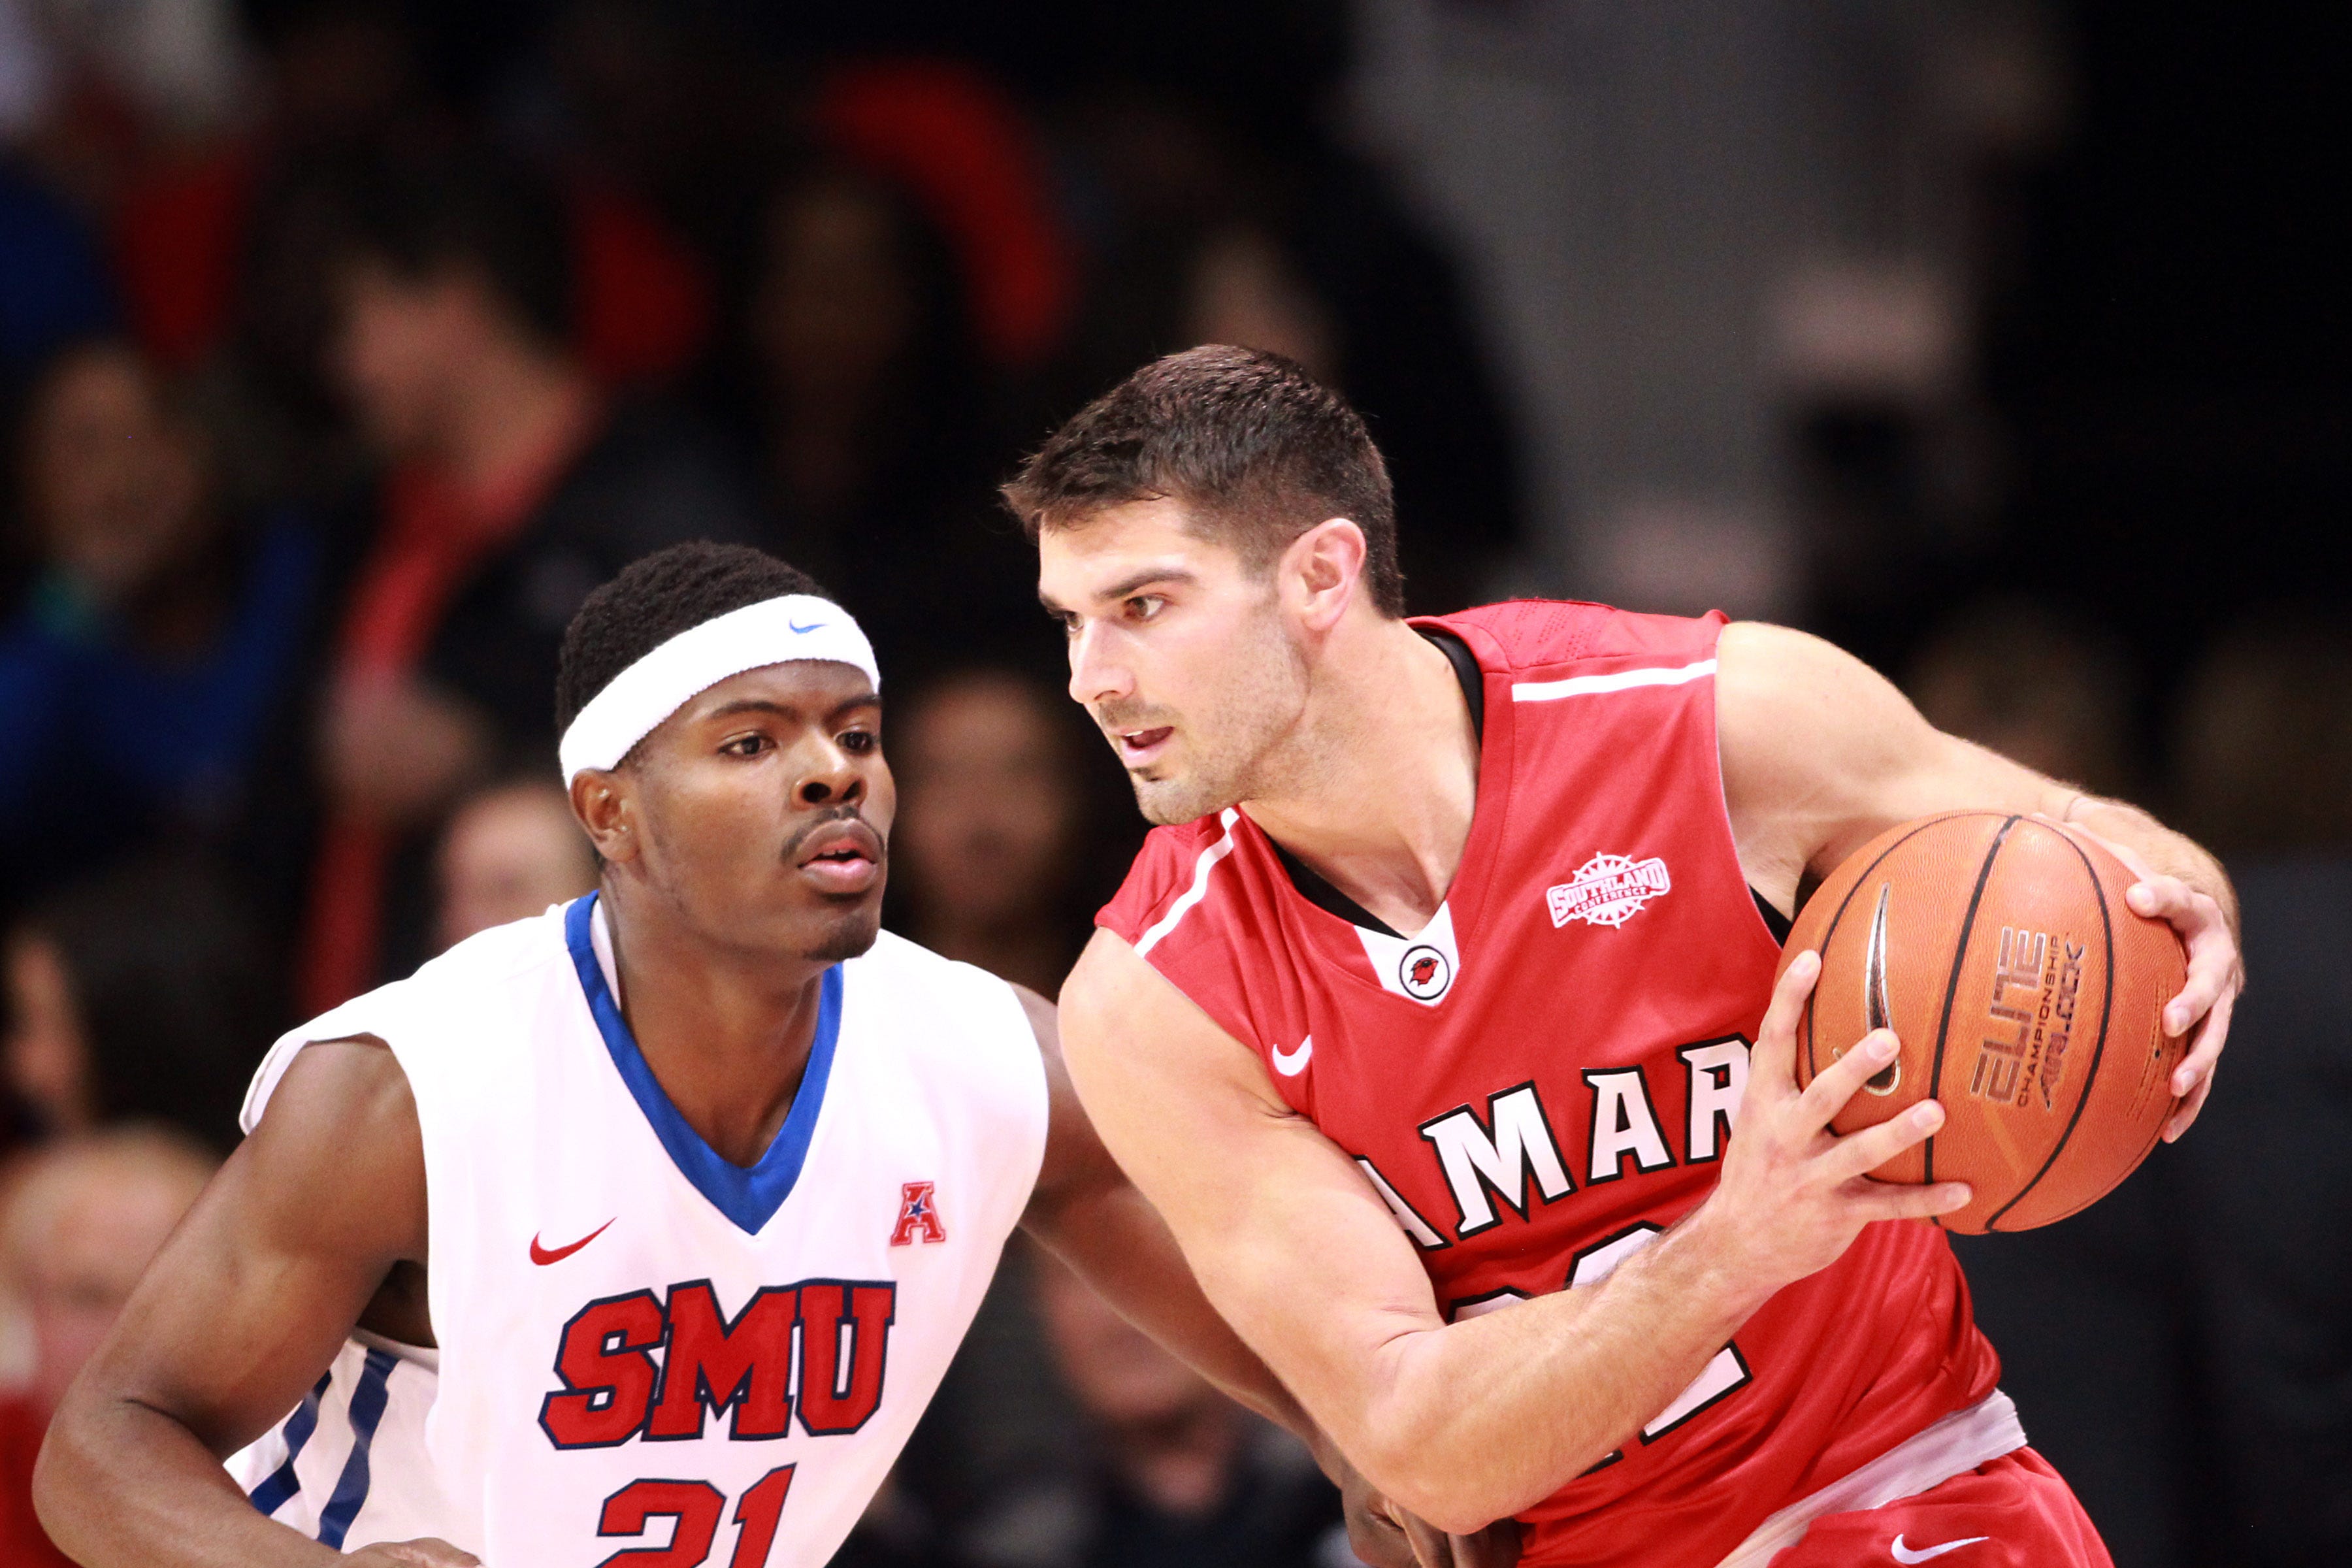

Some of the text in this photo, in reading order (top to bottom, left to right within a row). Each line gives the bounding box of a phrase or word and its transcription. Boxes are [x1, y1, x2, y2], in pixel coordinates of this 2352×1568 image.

[1551, 862, 1667, 920] SOUTHLAND
[1574, 887, 1647, 915] CONFERENCE
[1970, 925, 2046, 1102] ELITE
[2017, 935, 2059, 1107] CHAMPIONSHIP
[538, 1278, 897, 1450] SMU
[593, 1462, 797, 1568] 21
